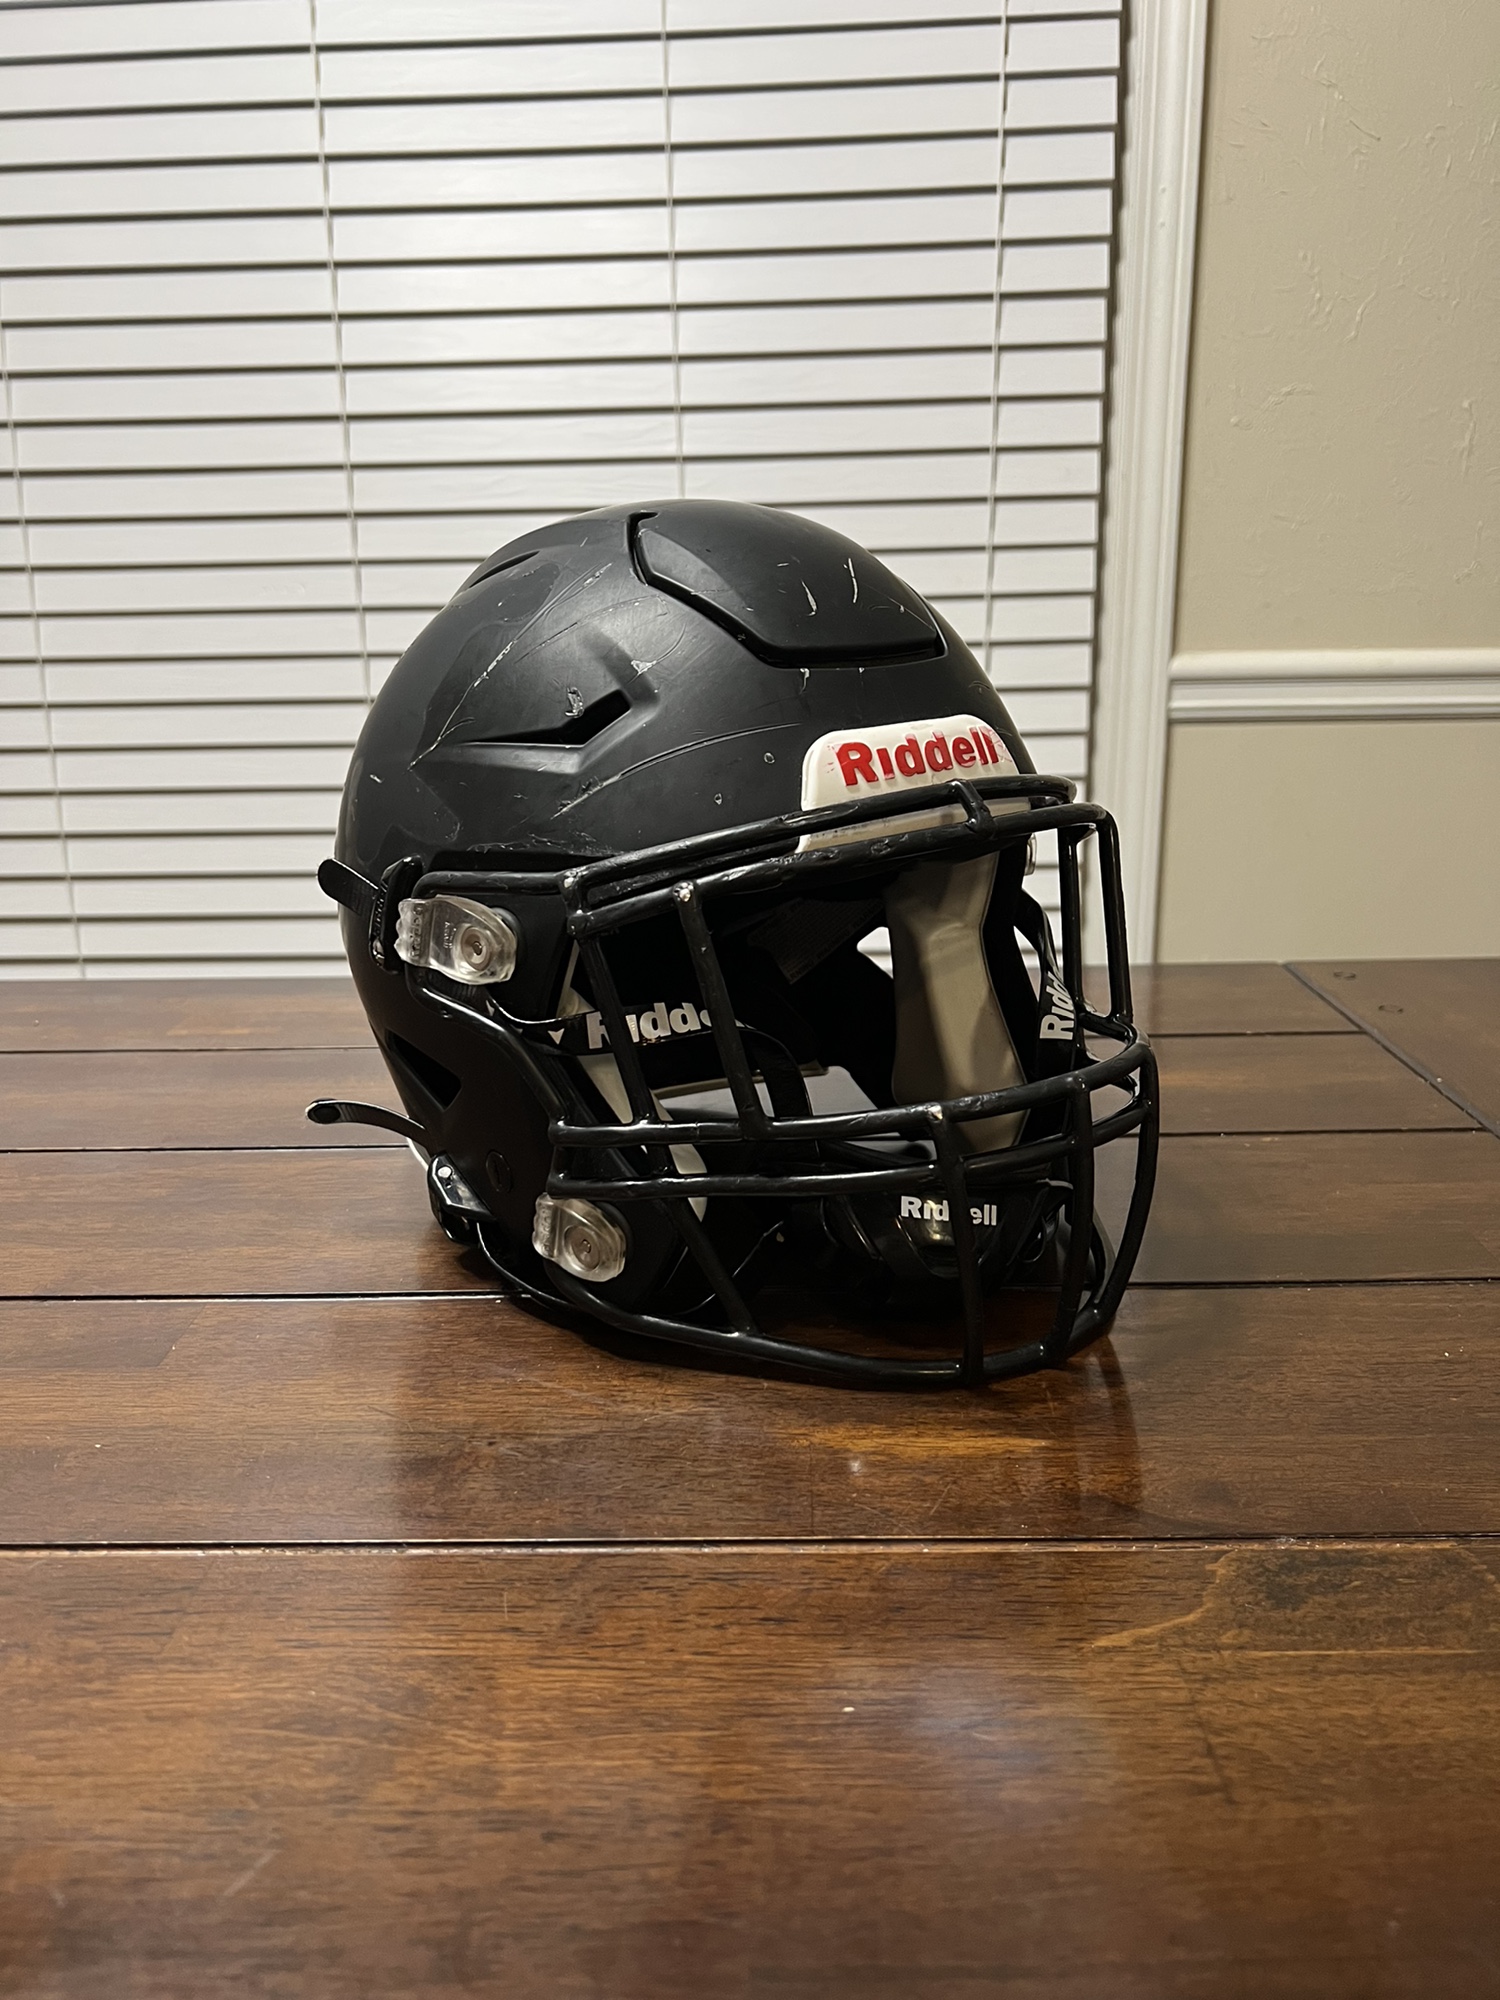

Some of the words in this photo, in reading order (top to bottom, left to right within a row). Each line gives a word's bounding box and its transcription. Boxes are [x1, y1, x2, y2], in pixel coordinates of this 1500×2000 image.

[836, 726, 1001, 787] Riddell
[1040, 971, 1075, 1040] Ridd
[901, 1195, 997, 1226] Ridell
